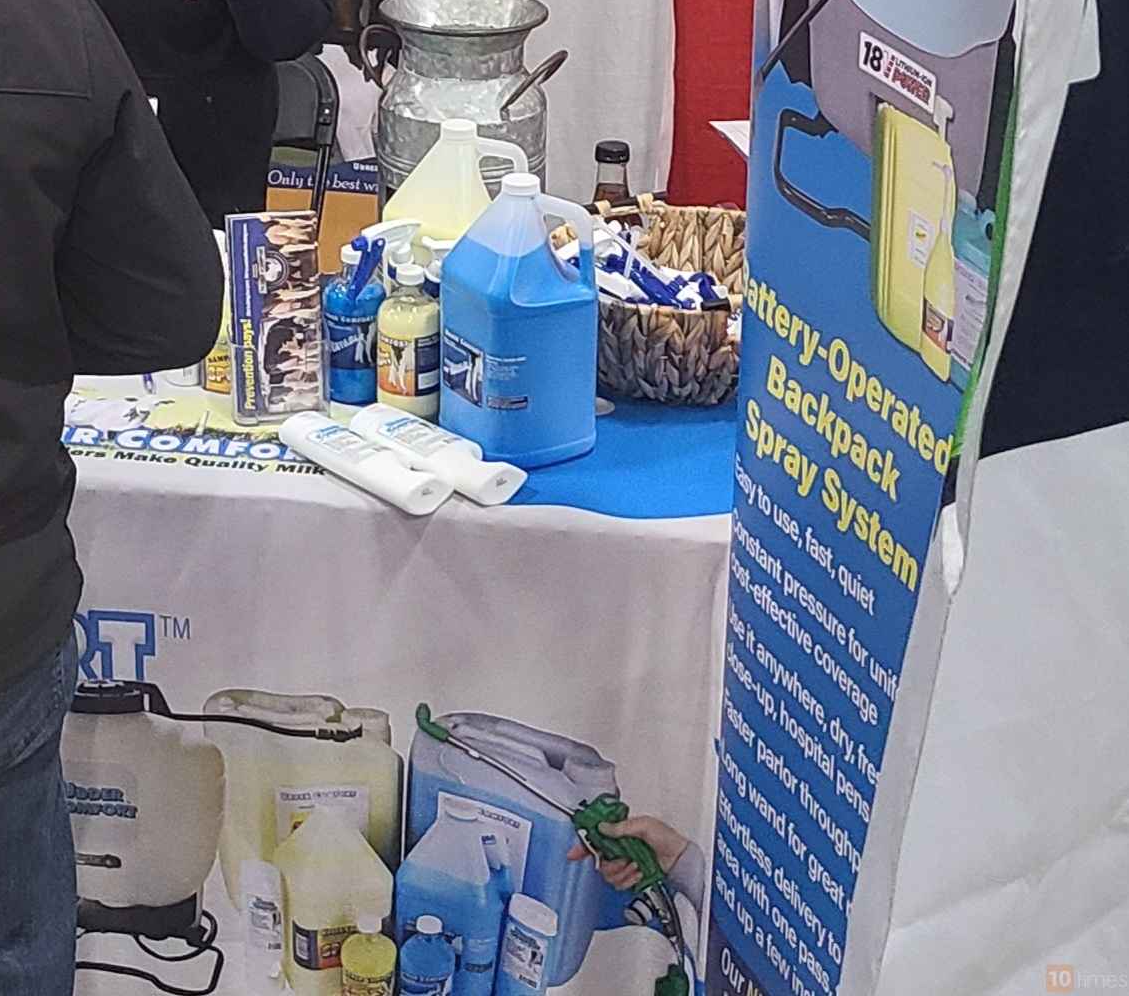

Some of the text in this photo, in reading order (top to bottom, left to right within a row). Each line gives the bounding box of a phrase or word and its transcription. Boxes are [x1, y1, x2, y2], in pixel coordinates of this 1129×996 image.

[863, 41, 883, 72] 18
[267, 169, 303, 188] Only
[332, 173, 360, 190] best
[242, 350, 256, 410] Prevention
[766, 354, 901, 501] Backpack
[114, 450, 177, 464] Make
[184, 456, 269, 473] Quality
[276, 463, 328, 476] Milk
[746, 399, 919, 592] Spray System
[733, 508, 782, 584] onstant
[784, 570, 846, 646] pressure
[848, 628, 868, 668] for
[757, 484, 771, 516] to
[774, 504, 802, 548] use,
[806, 527, 836, 581] fast,
[838, 565, 876, 616] quiet
[746, 622, 756, 654] it
[756, 642, 826, 732] anywhere,
[830, 717, 855, 765] dry,
[858, 744, 880, 788] fre
[814, 637, 878, 725] coverage
[757, 738, 798, 795] parlor
[779, 701, 834, 781] hospital
[836, 770, 870, 823] pens
[719, 787, 841, 965] Effortless delivery to
[749, 780, 786, 836] wand
[787, 822, 807, 863] for
[808, 852, 845, 911] great
[715, 868, 735, 913] and
[736, 899, 753, 936] up
[755, 920, 765, 949] a
[766, 934, 790, 981] few
[741, 867, 770, 918] with
[772, 907, 797, 949] one
[721, 947, 746, 994] Our
